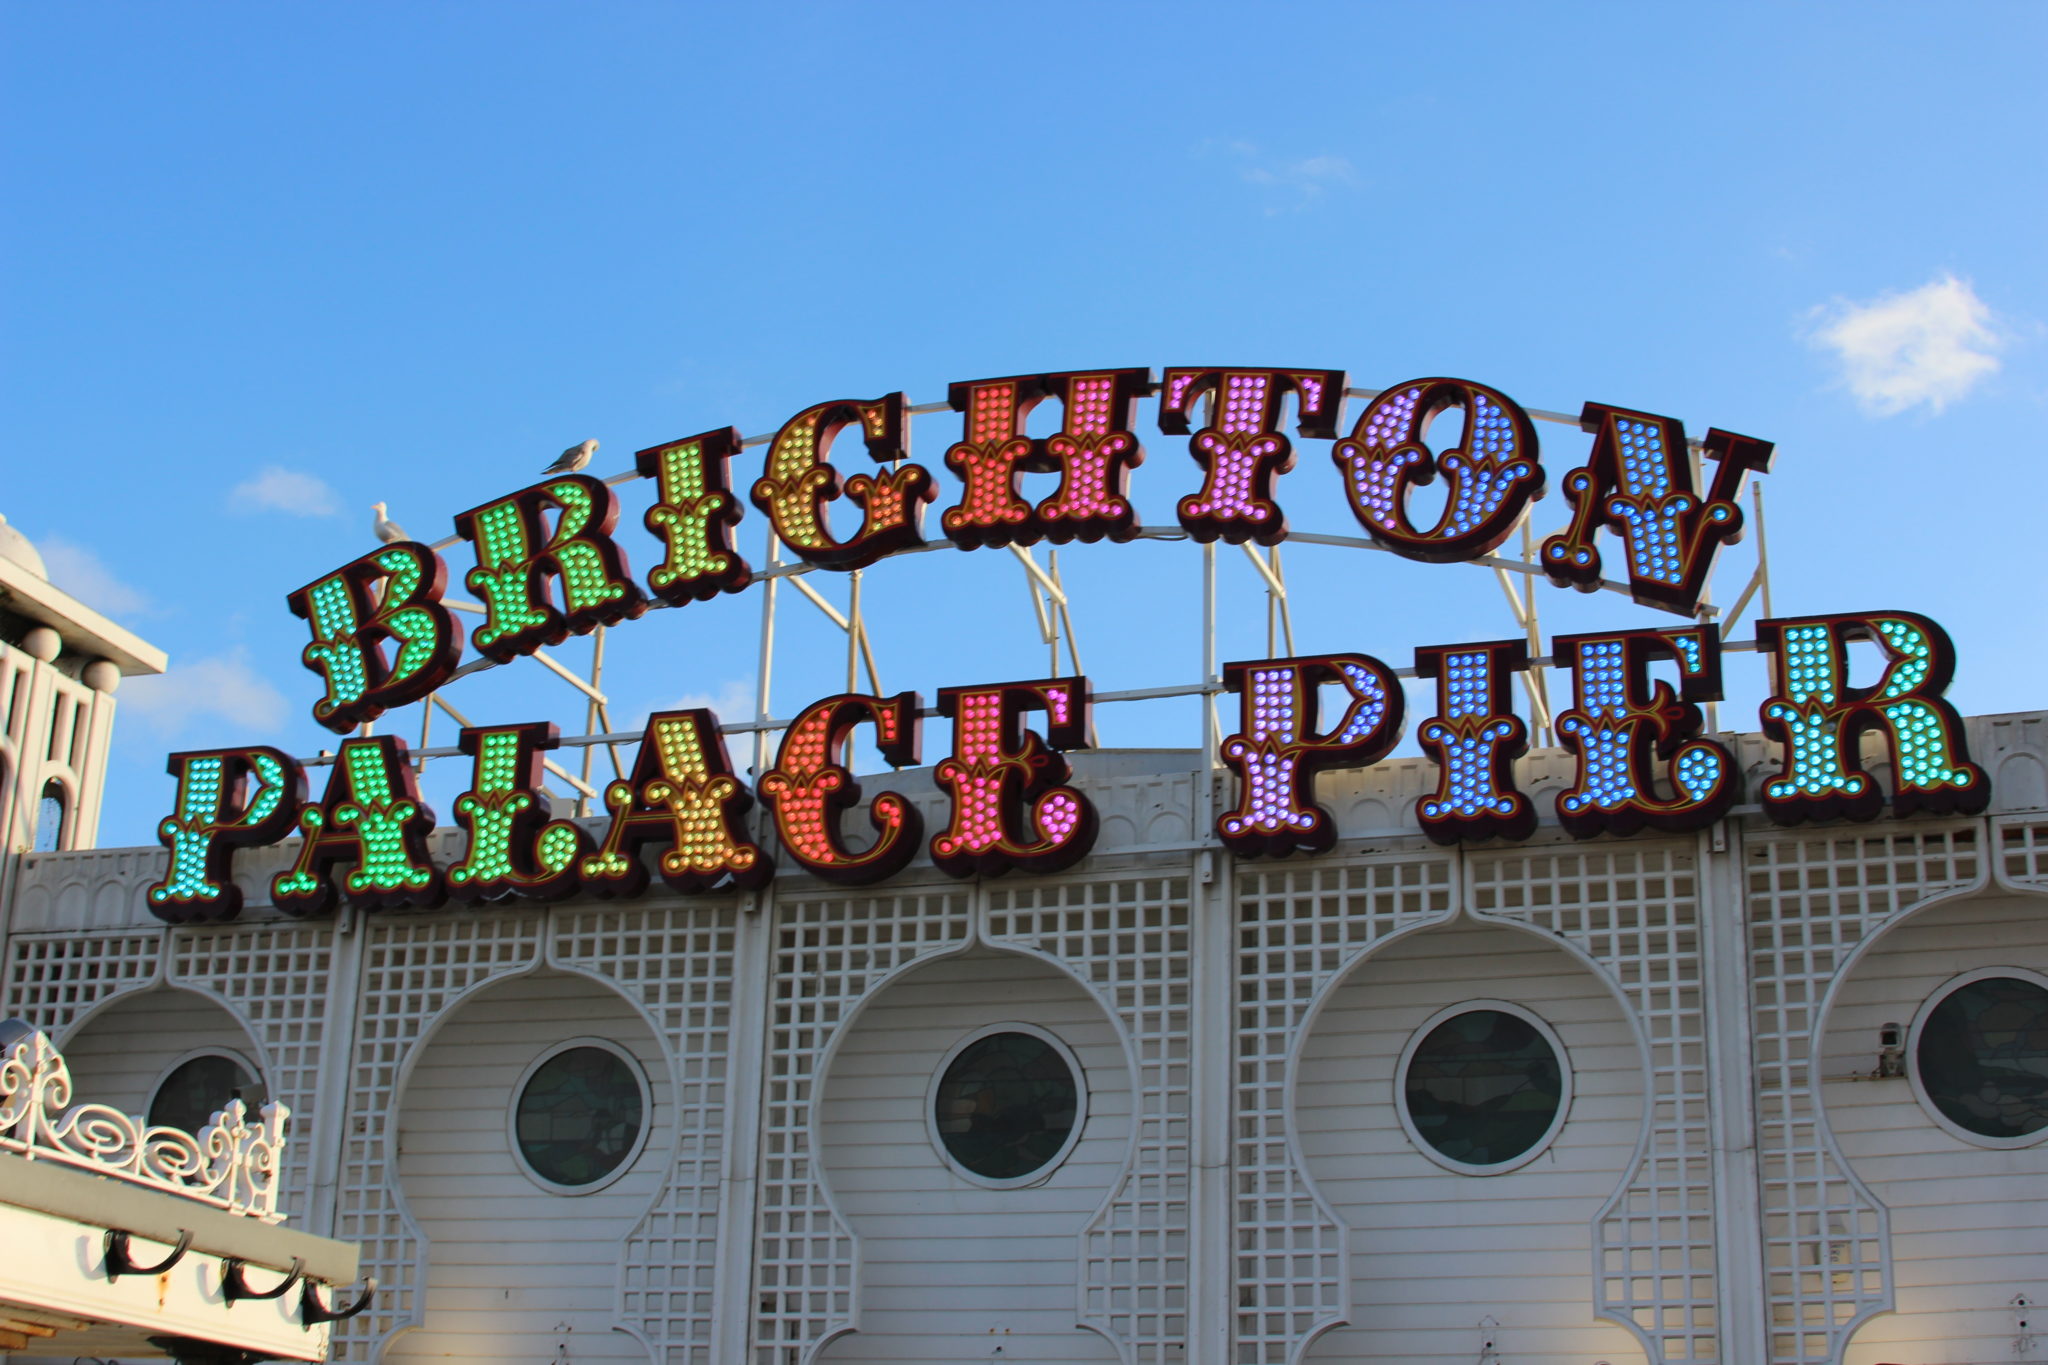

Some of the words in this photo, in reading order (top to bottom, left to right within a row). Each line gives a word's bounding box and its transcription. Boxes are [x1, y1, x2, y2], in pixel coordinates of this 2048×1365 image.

[287, 366, 1775, 735] BRIGHTON
[147, 676, 1099, 923] PALACE
[1218, 611, 1992, 858] PIER
